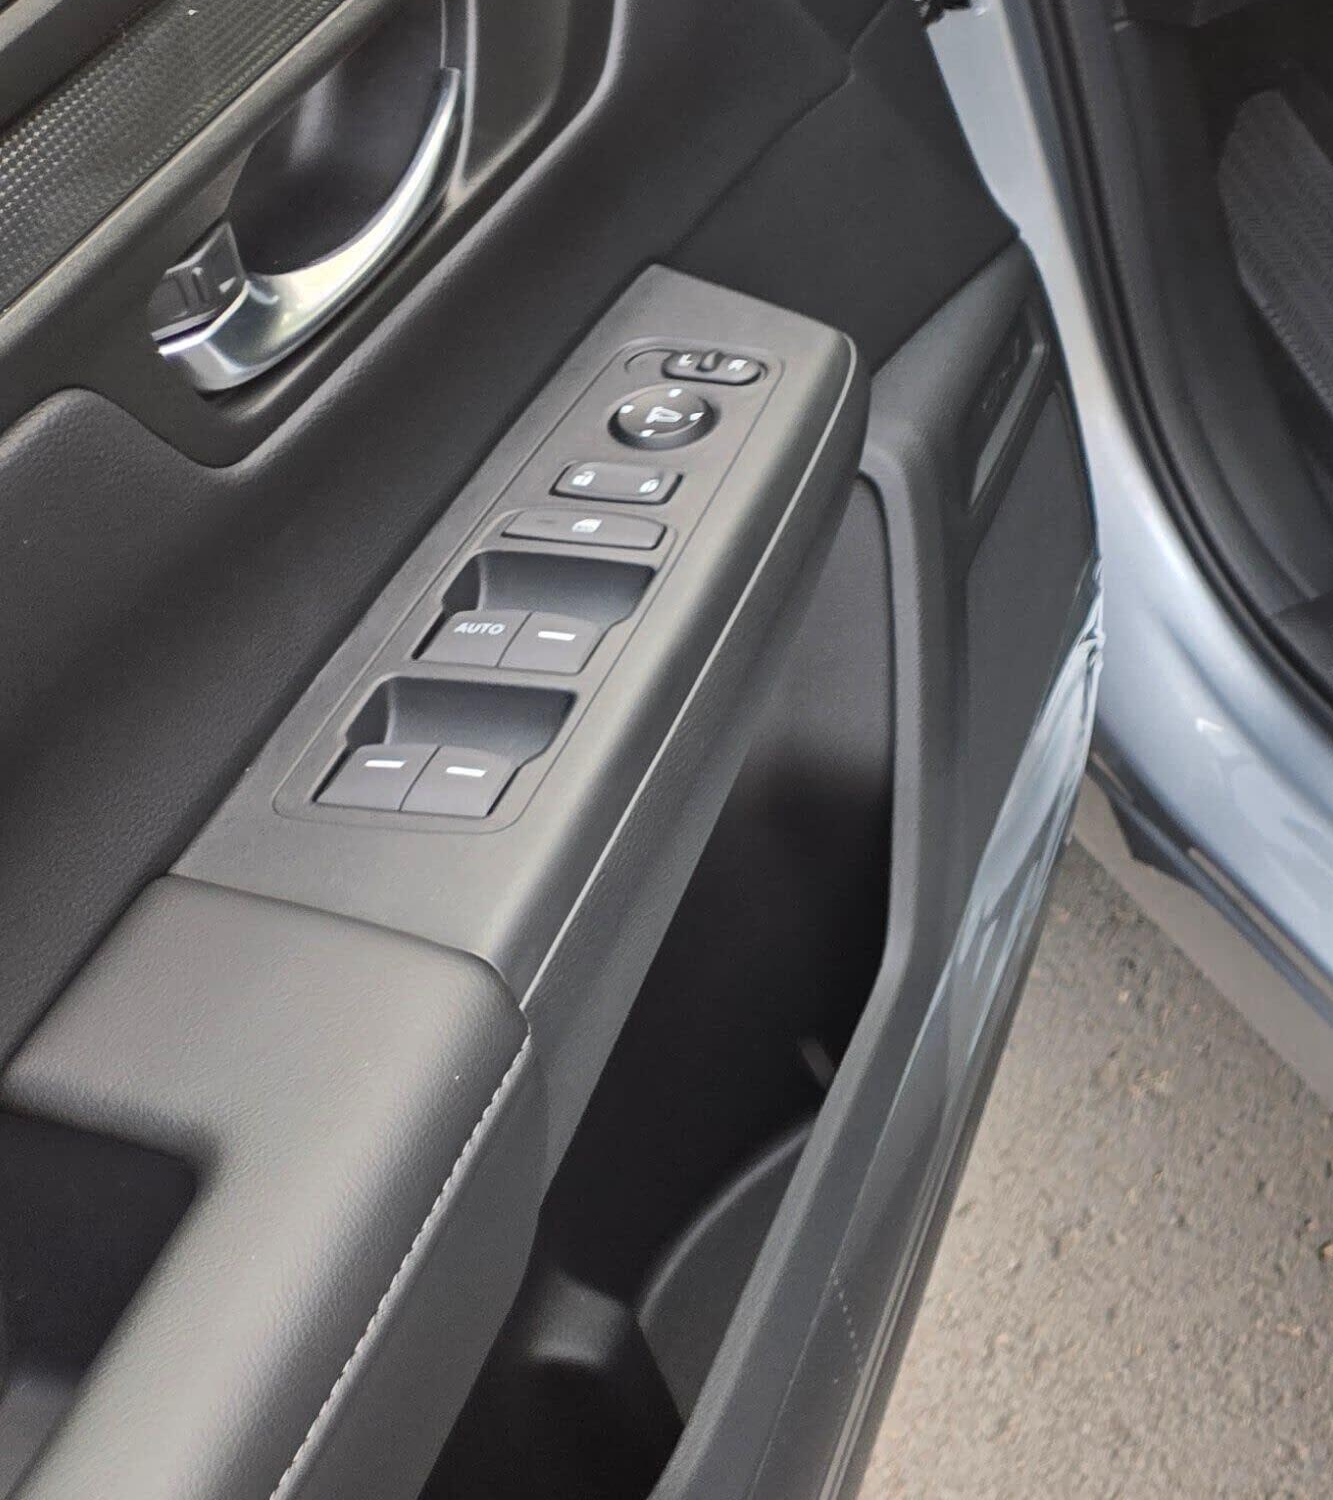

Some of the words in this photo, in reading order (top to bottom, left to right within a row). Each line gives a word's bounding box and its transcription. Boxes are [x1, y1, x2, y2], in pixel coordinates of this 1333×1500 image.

[678, 353, 693, 366] L
[728, 359, 748, 372] R
[454, 622, 506, 636] AUTO
